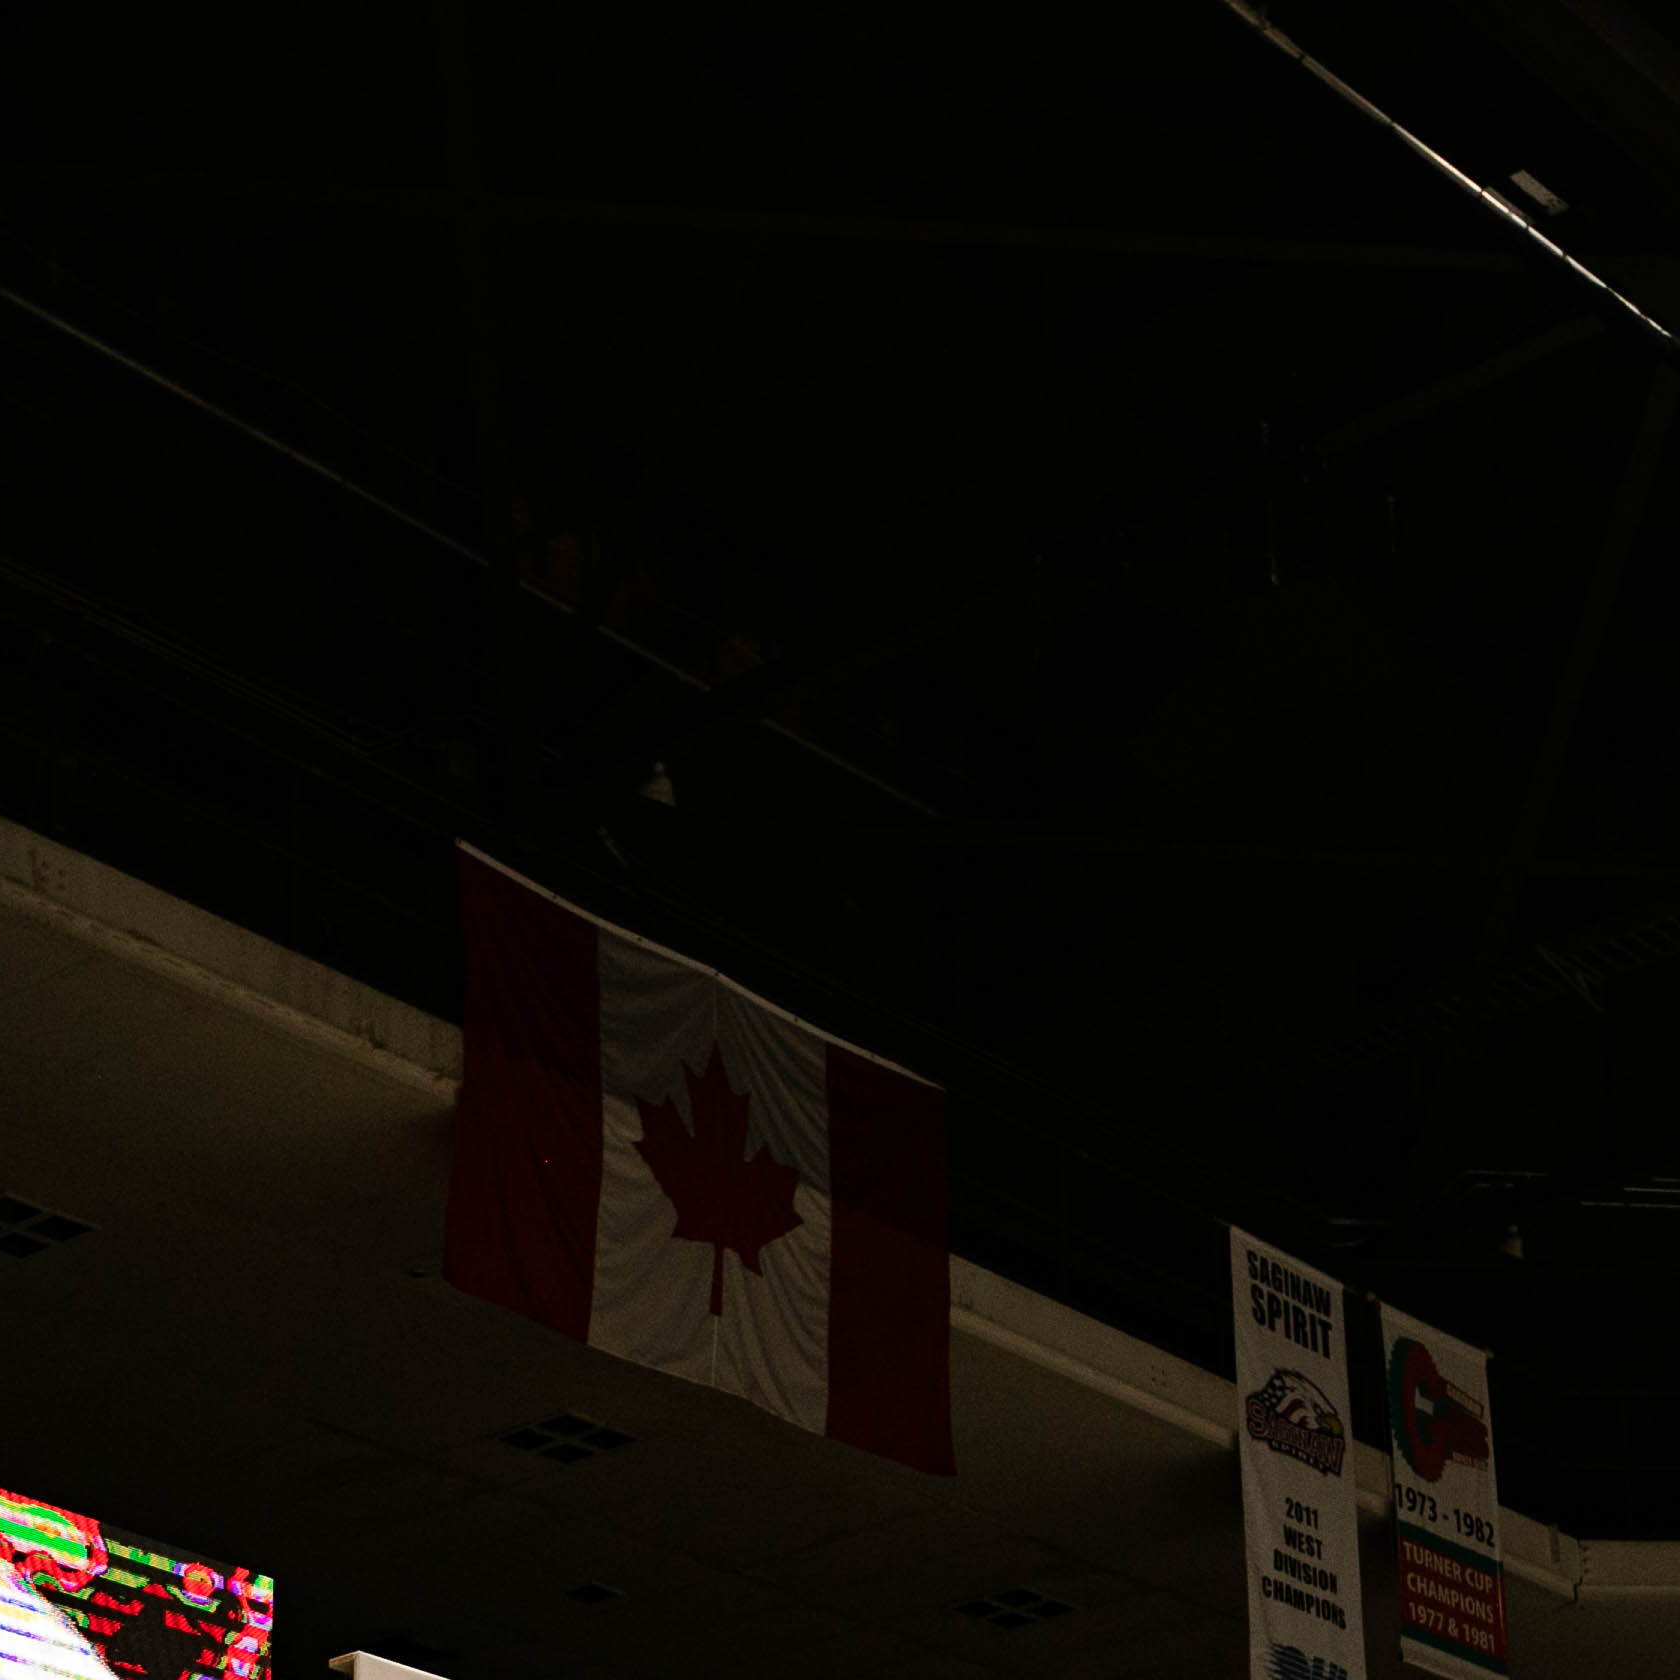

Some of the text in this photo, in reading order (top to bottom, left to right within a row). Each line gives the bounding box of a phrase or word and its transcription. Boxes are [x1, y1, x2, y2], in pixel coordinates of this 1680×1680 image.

[1246, 1250, 1332, 1319] SAGINAW
[1250, 1284, 1333, 1360] SPIRIT
[1285, 1497, 1319, 1530] 2011
[1394, 1483, 1438, 1523] 1973
[1454, 1508, 1495, 1548] 1982
[1283, 1524, 1323, 1560] WEST
[1403, 1540, 1494, 1593] TURNER CUP
[1273, 1549, 1338, 1595] DIVISION
[1406, 1571, 1495, 1624] CHAMPIONS
[1261, 1576, 1346, 1630] CHAMPIONS
[1408, 1601, 1496, 1654] 1977 & 1981
